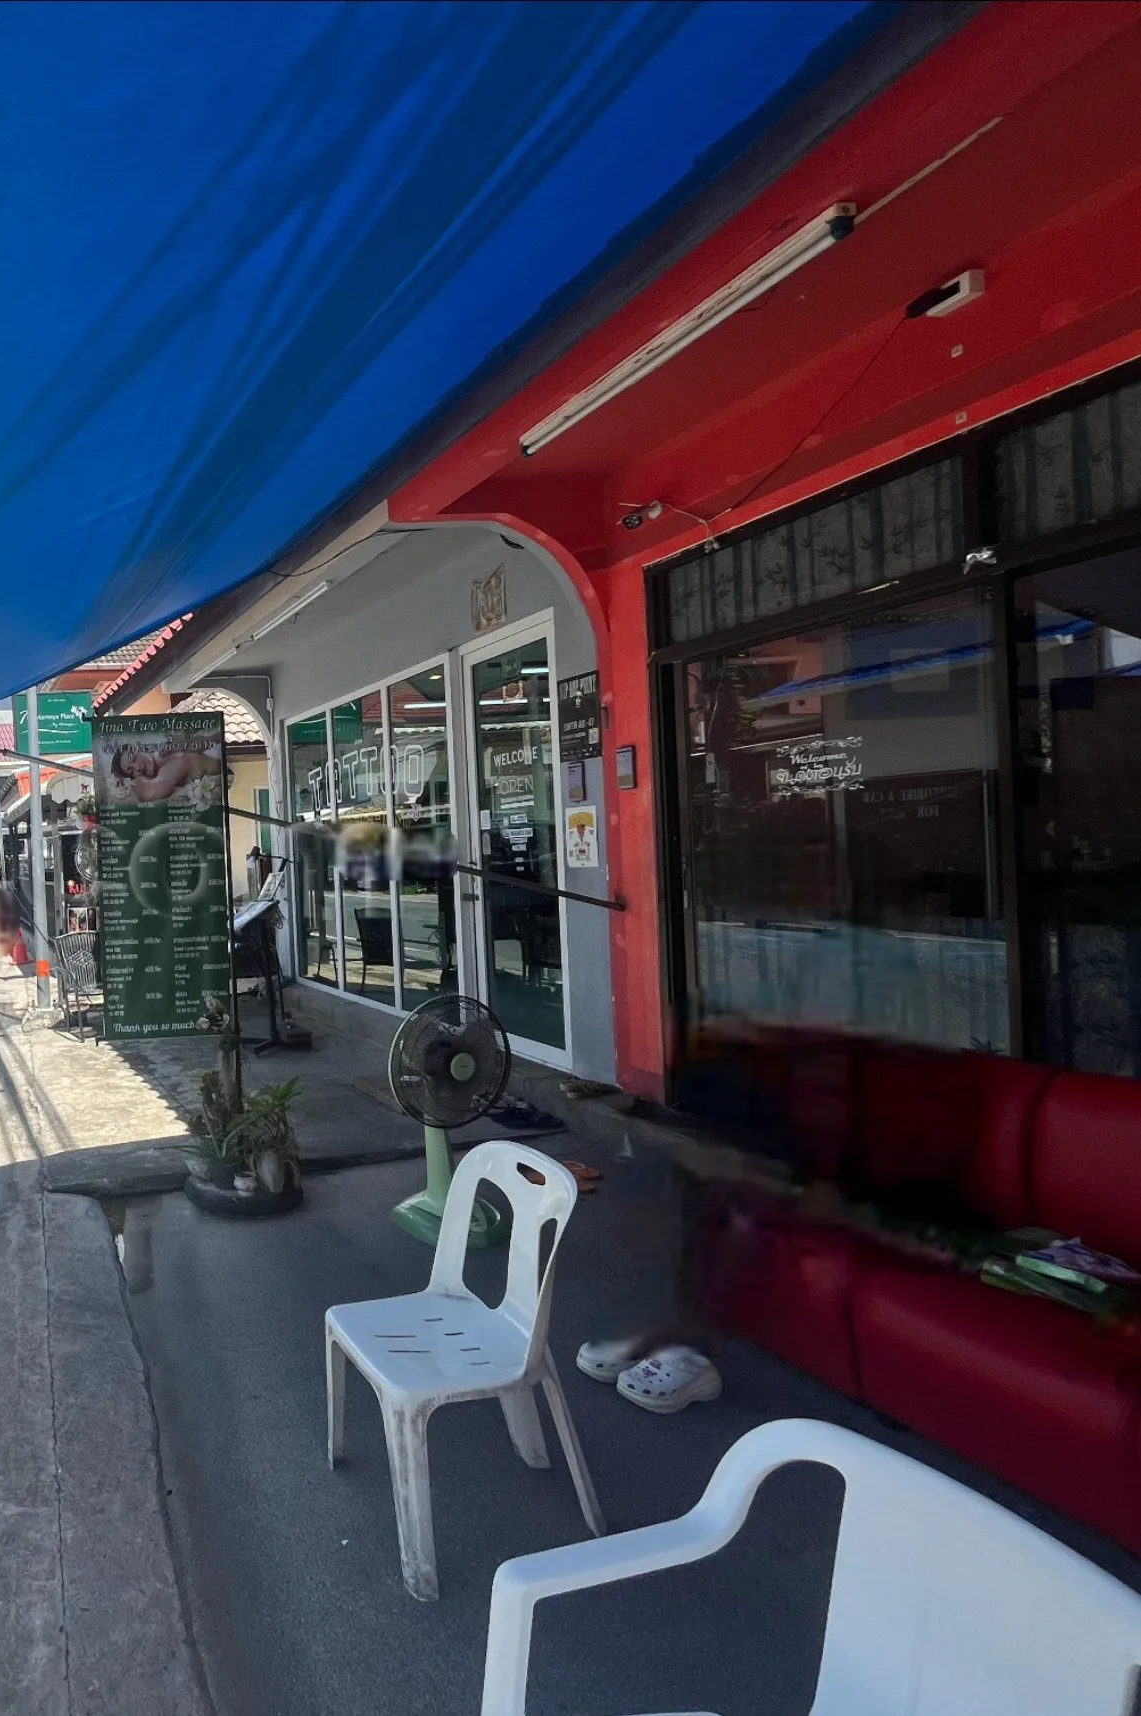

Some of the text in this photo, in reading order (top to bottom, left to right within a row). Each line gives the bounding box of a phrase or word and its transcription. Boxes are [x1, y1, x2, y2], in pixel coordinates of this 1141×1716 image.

[128, 719, 158, 732] Two
[161, 716, 216, 733] Massage
[493, 746, 538, 767] WELCOME
[790, 753, 848, 765] Welcome
[308, 744, 425, 812] TATTOO
[776, 757, 863, 783] ยินดีต้อนรับ
[499, 778, 534, 796] OPEN
[113, 1020, 195, 1035] Thank you so much
